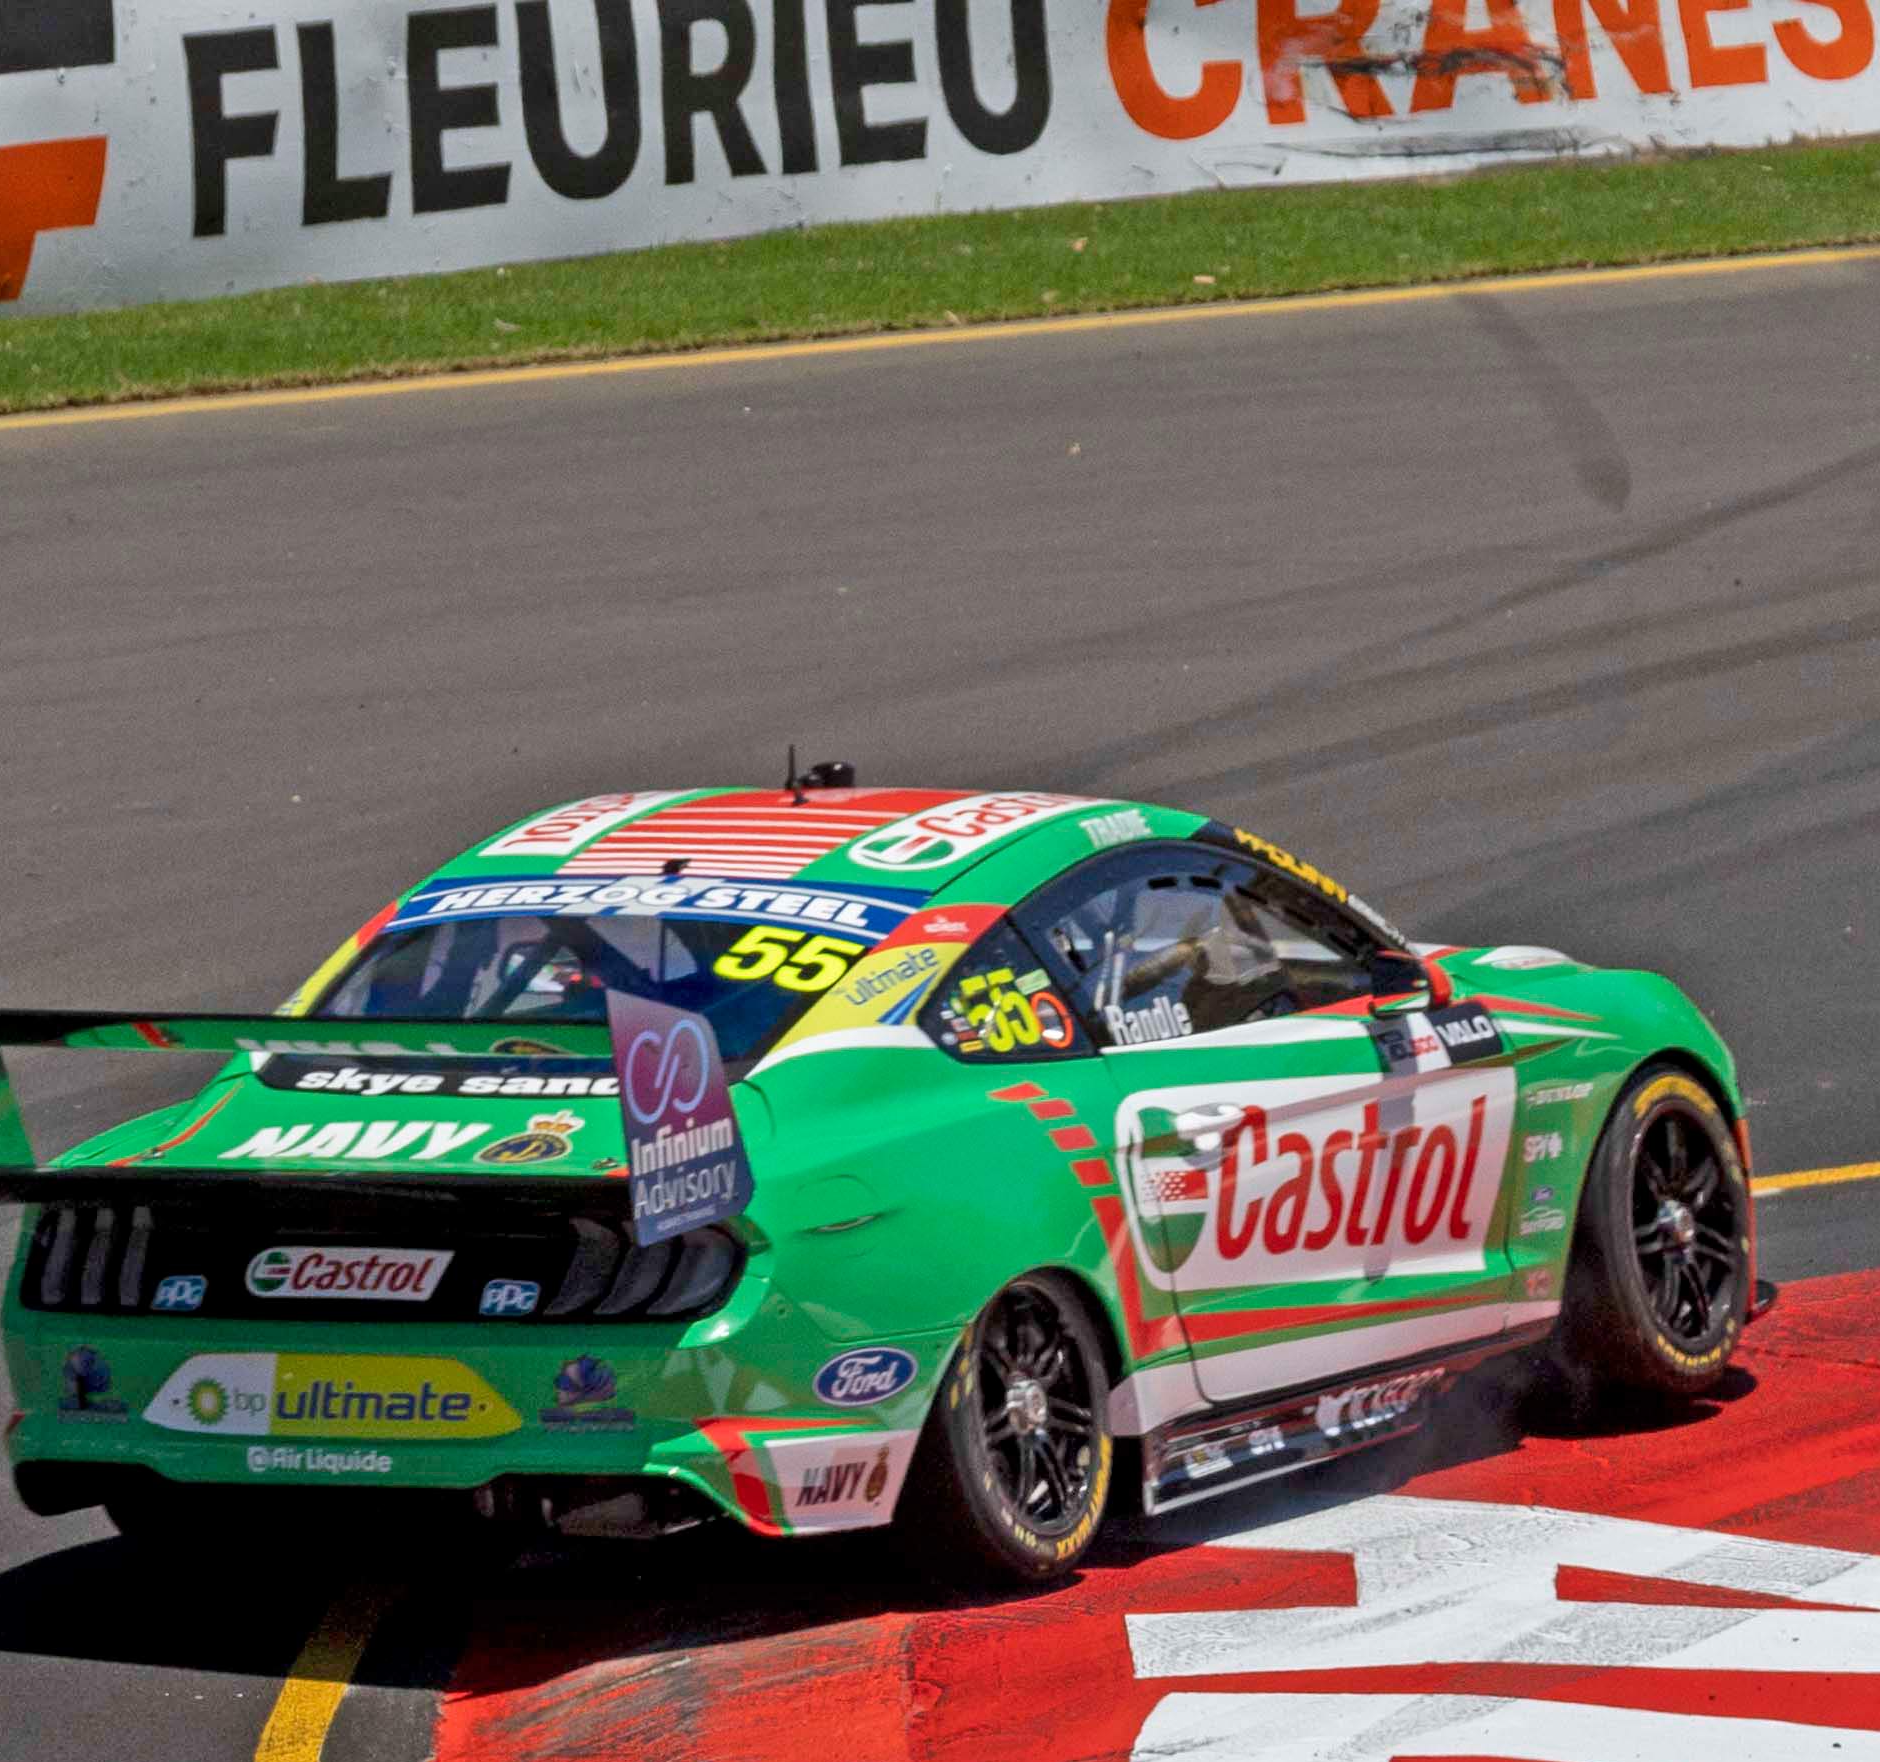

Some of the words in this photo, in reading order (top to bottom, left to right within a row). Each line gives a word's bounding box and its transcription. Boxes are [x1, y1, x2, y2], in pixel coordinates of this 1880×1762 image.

[182, 0, 1052, 238] FLEURIEU
[430, 881, 692, 914] HERZOG
[694, 886, 870, 928] STEEL
[714, 925, 866, 991] 55
[845, 944, 940, 1006] ultimate
[960, 967, 1042, 1052] 55
[1105, 996, 1194, 1046] Randle
[1436, 1015, 1496, 1047] VALO
[294, 1066, 446, 1096] skye
[219, 1120, 493, 1160] NAVY
[631, 1117, 734, 1176] Infinium
[633, 1159, 738, 1221] Advisory
[1215, 1094, 1488, 1261] Castrol
[291, 1252, 434, 1293] Castrol
[831, 1354, 898, 1398] Ford
[233, 1387, 267, 1416] bp
[276, 1381, 472, 1422] ultimate
[795, 1460, 867, 1507] NAVY
